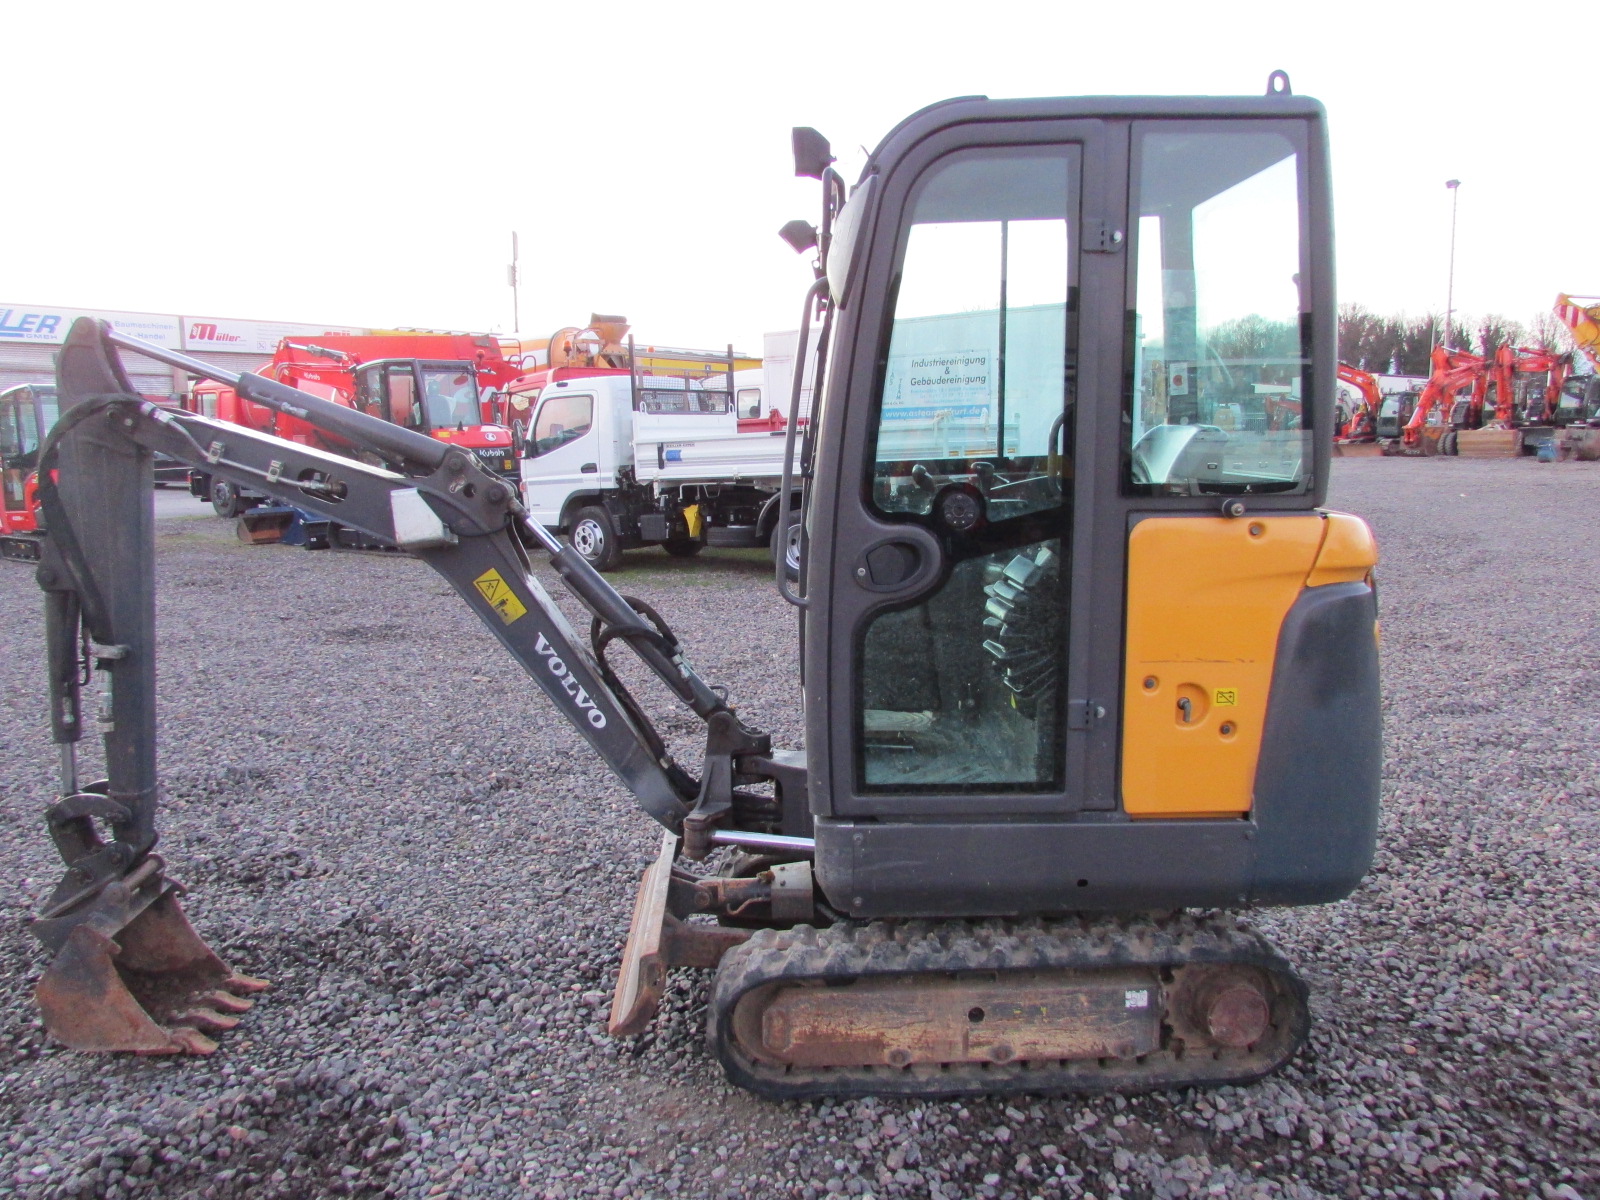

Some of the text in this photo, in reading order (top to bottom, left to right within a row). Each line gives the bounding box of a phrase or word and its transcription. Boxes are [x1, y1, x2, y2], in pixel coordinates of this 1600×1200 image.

[0, 308, 62, 334] LER
[911, 356, 986, 368] Industriereinigung
[944, 366, 951, 375] &
[910, 375, 986, 386] Gebäudereinigung
[479, 449, 505, 457] Kubota
[534, 631, 607, 729] VOLVO
